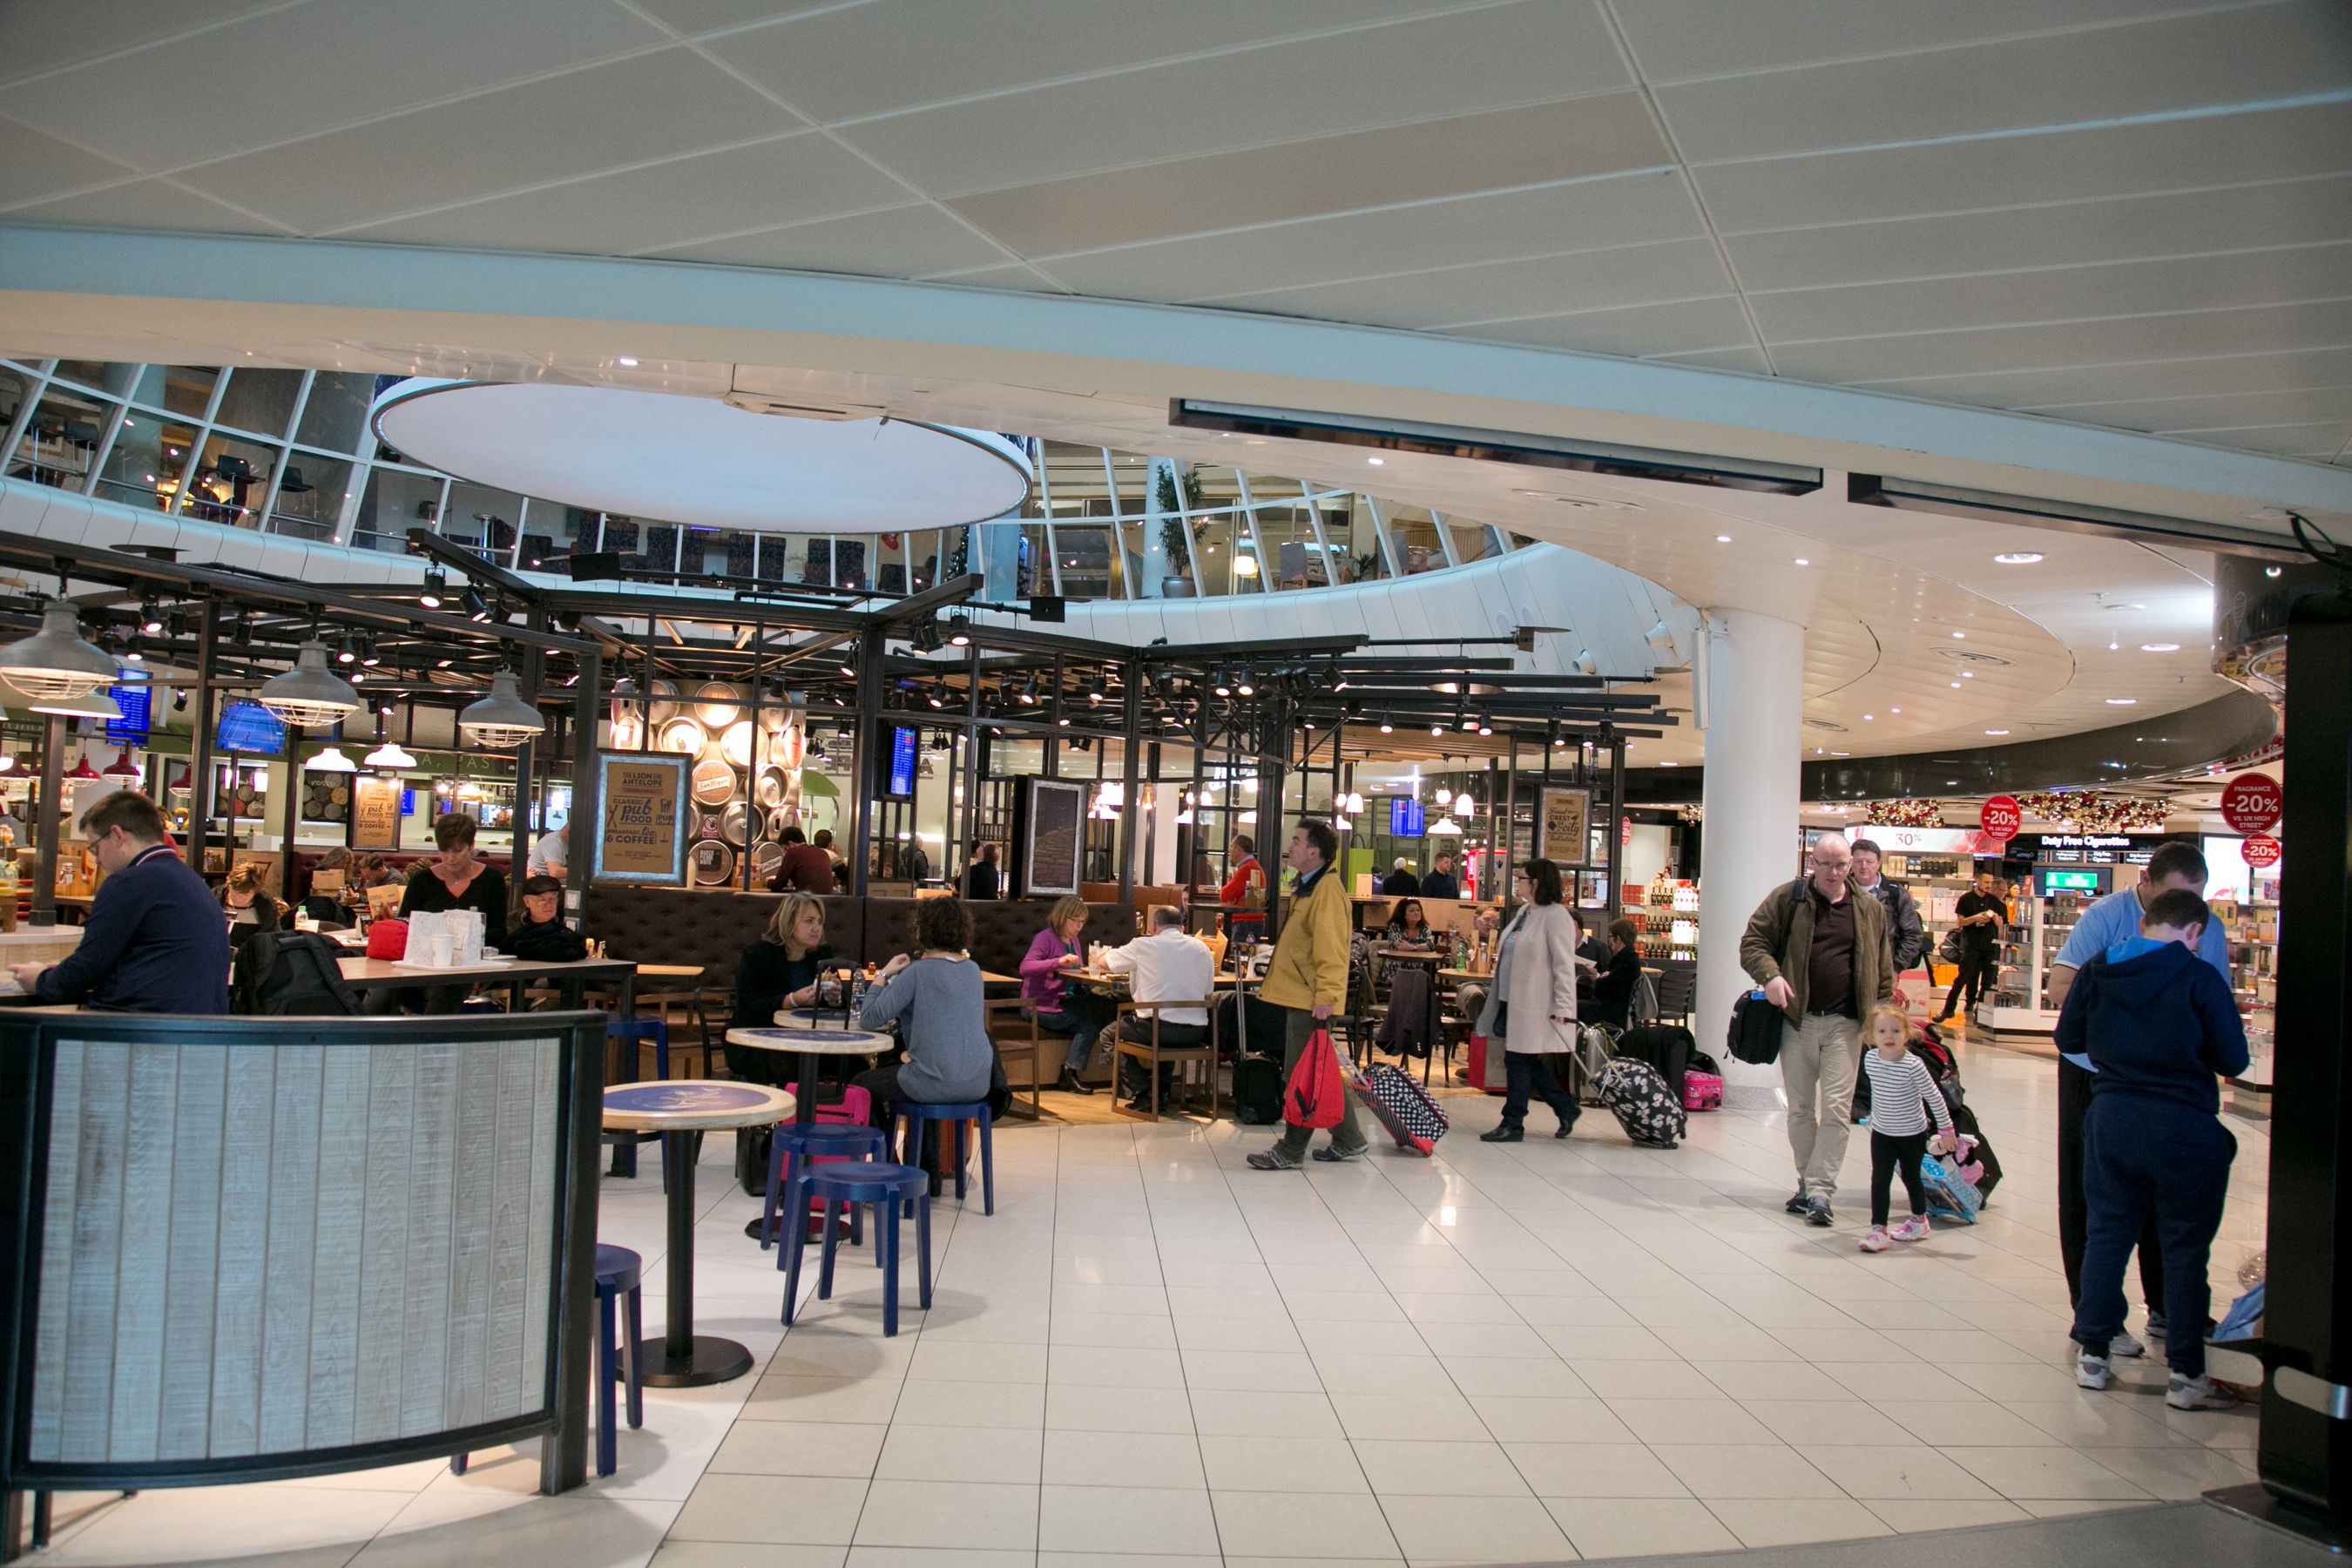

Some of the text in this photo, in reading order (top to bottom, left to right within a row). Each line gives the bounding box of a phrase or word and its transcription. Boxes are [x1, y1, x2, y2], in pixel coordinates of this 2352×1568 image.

[620, 799, 652, 821] pub
[2227, 794, 2279, 813] -20%
[625, 814, 652, 823] FOOD
[1984, 810, 2017, 826] -20%
[641, 826, 655, 836] tea
[615, 835, 655, 844] COFFEE
[1895, 833, 1922, 846] 30%
[2041, 835, 2131, 848] Duty Free Cigarettes
[2244, 845, 2278, 856] -20%
